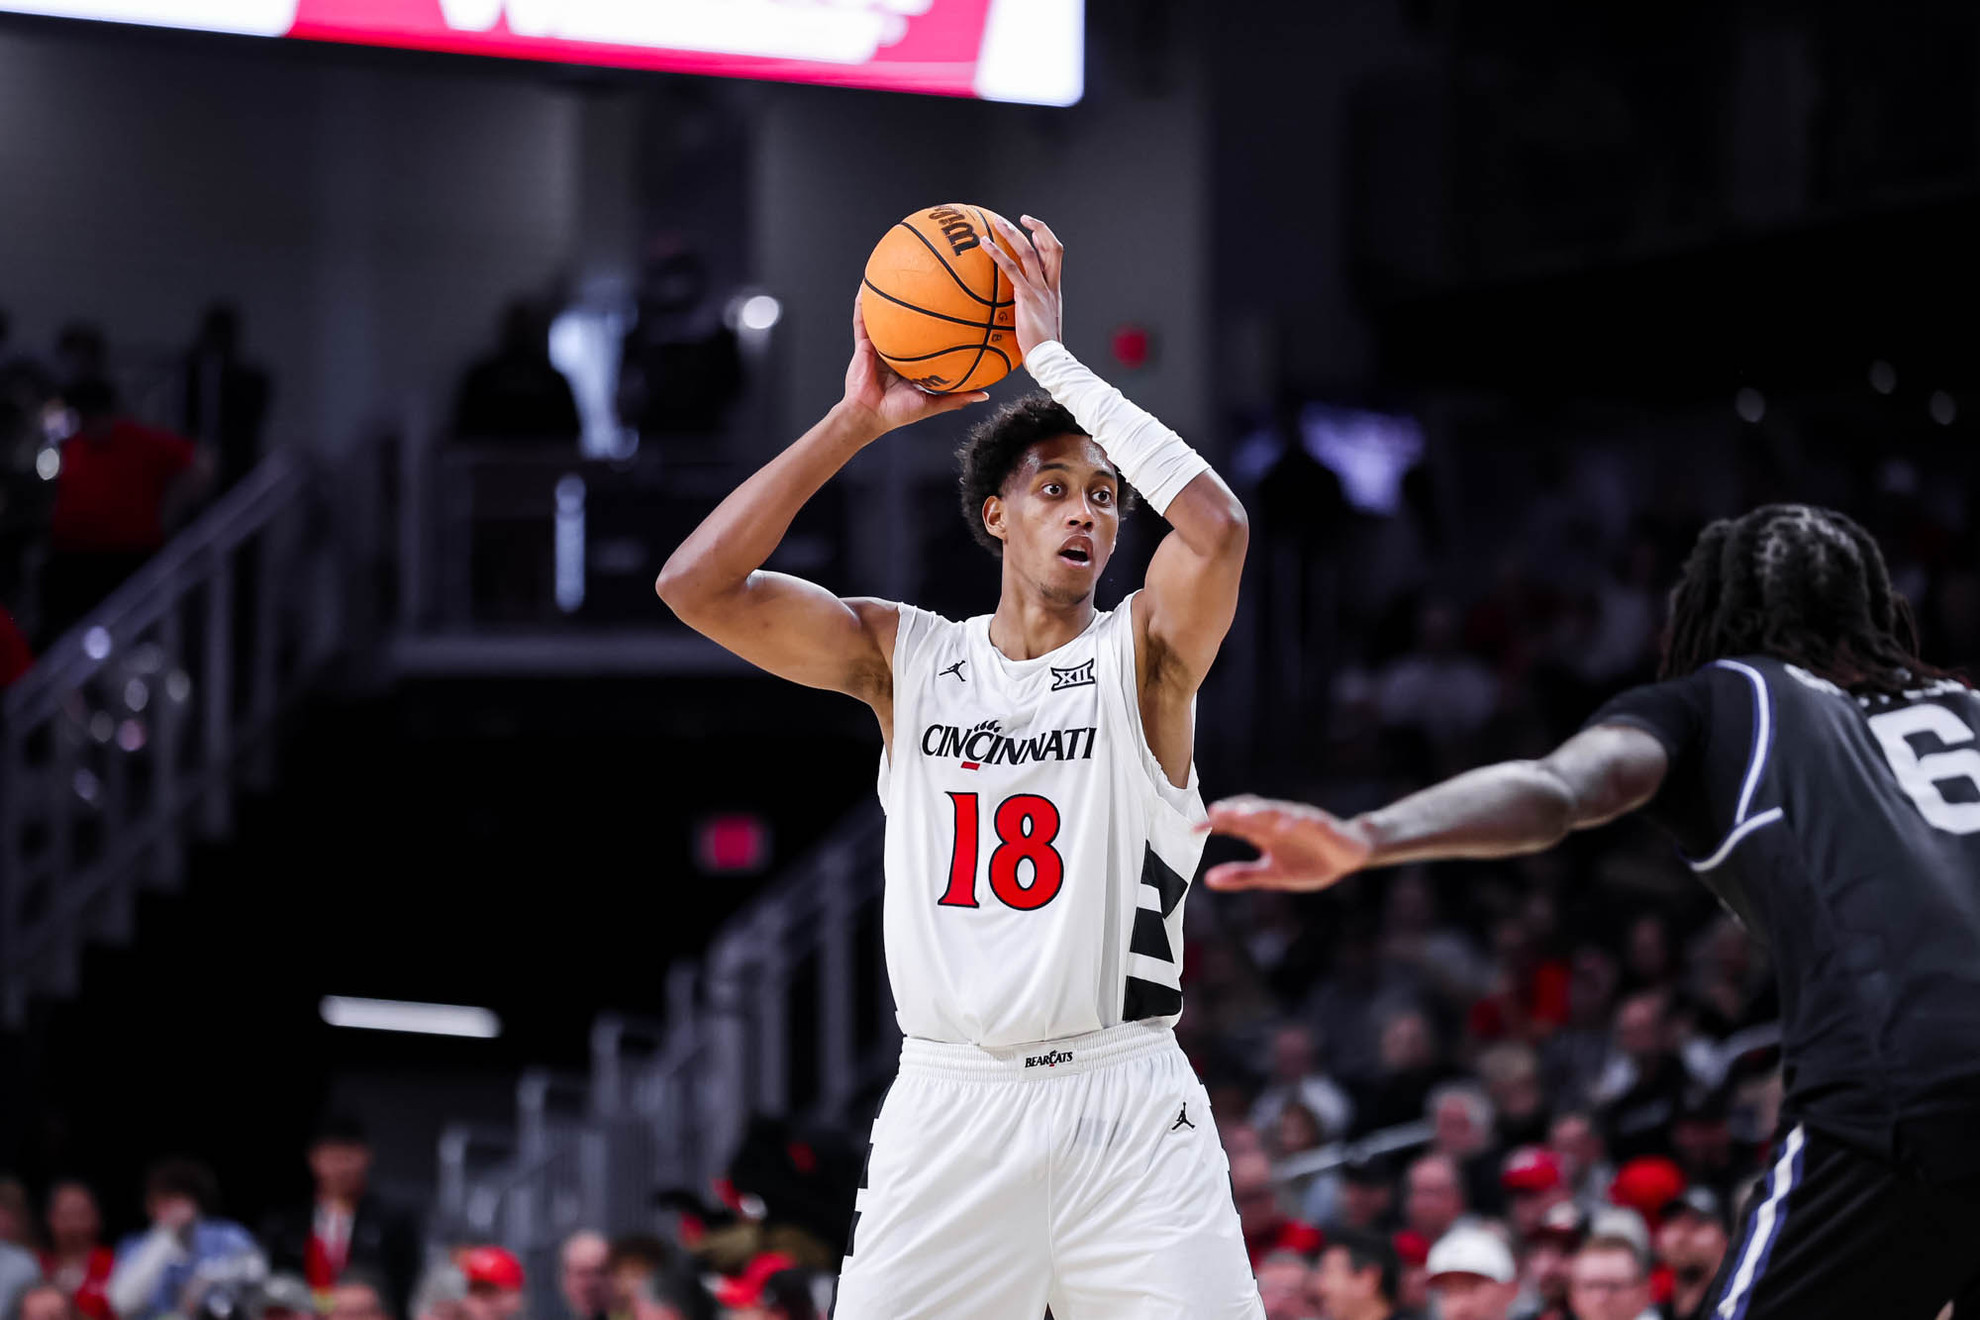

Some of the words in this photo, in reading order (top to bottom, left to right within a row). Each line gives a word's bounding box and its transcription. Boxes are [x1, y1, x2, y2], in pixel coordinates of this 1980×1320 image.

[929, 205, 981, 257] Wil
[1050, 658, 1096, 691] XII
[922, 721, 1096, 768] CINCINNATI
[1868, 703, 1980, 835] 6
[938, 791, 1064, 911] 18
[1025, 1050, 1073, 1068] BEARCATS
